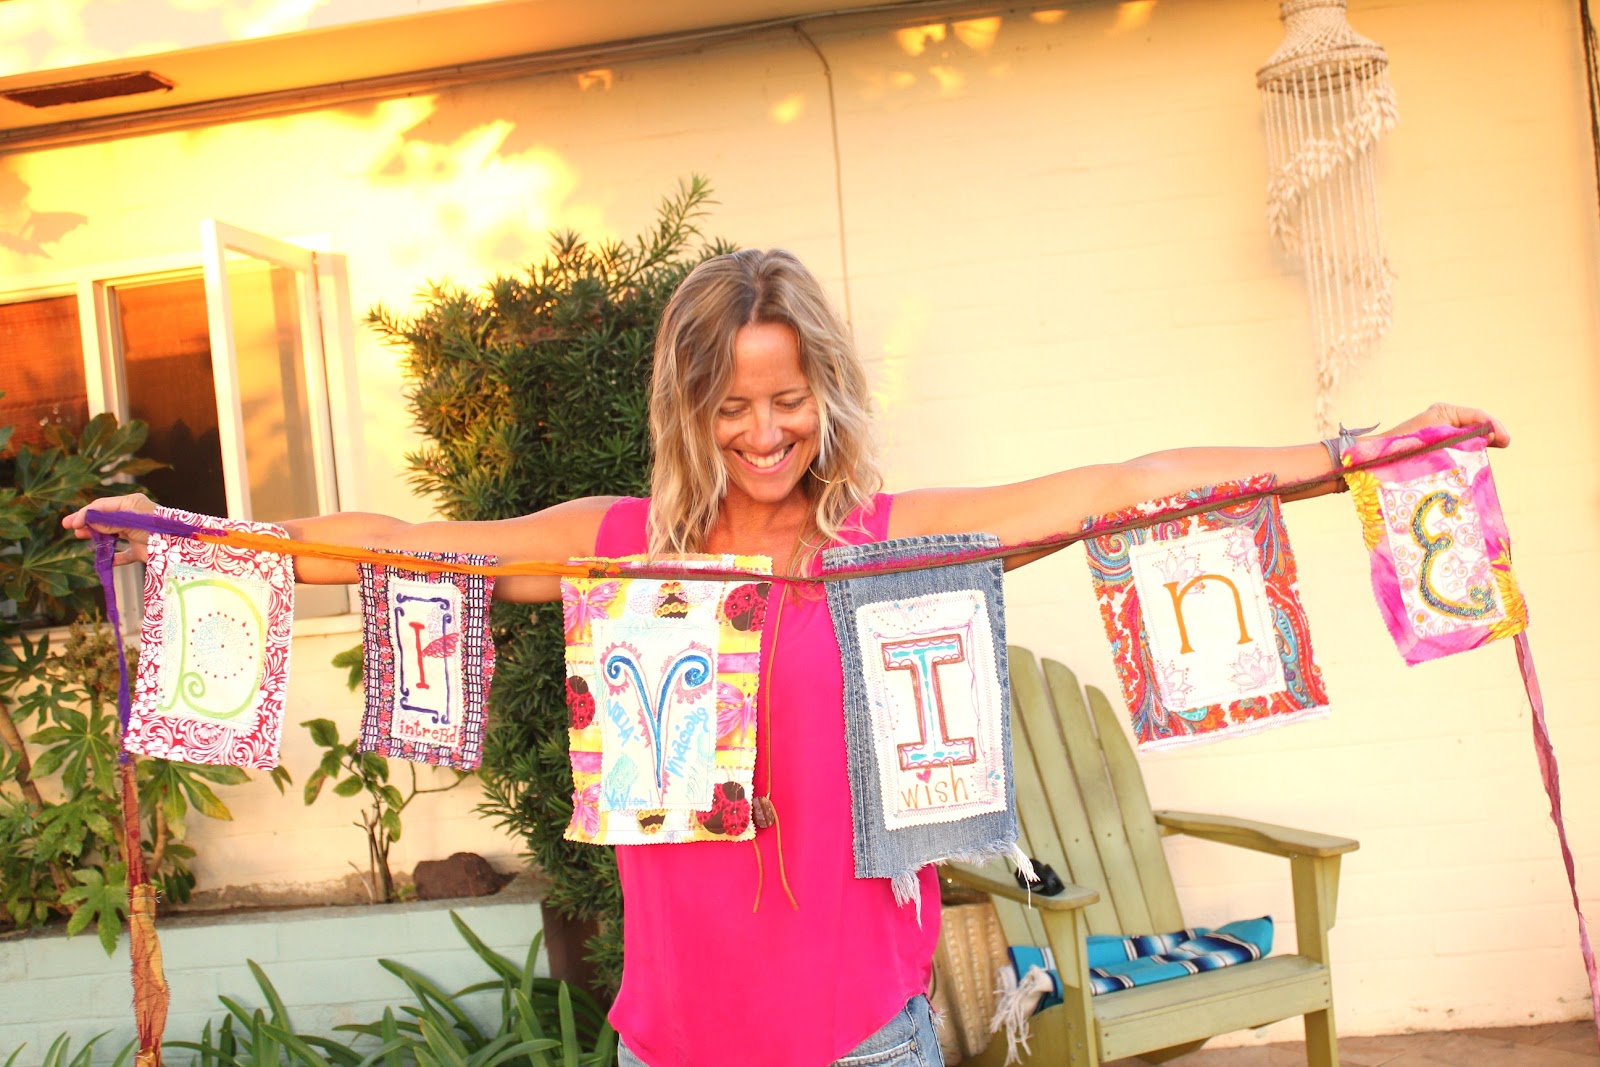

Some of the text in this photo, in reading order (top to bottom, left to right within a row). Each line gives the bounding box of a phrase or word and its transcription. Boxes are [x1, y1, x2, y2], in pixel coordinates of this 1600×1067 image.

[1162, 573, 1254, 655] n
[602, 645, 713, 802] V
[881, 633, 977, 771] I
[900, 764, 969, 808] wish
